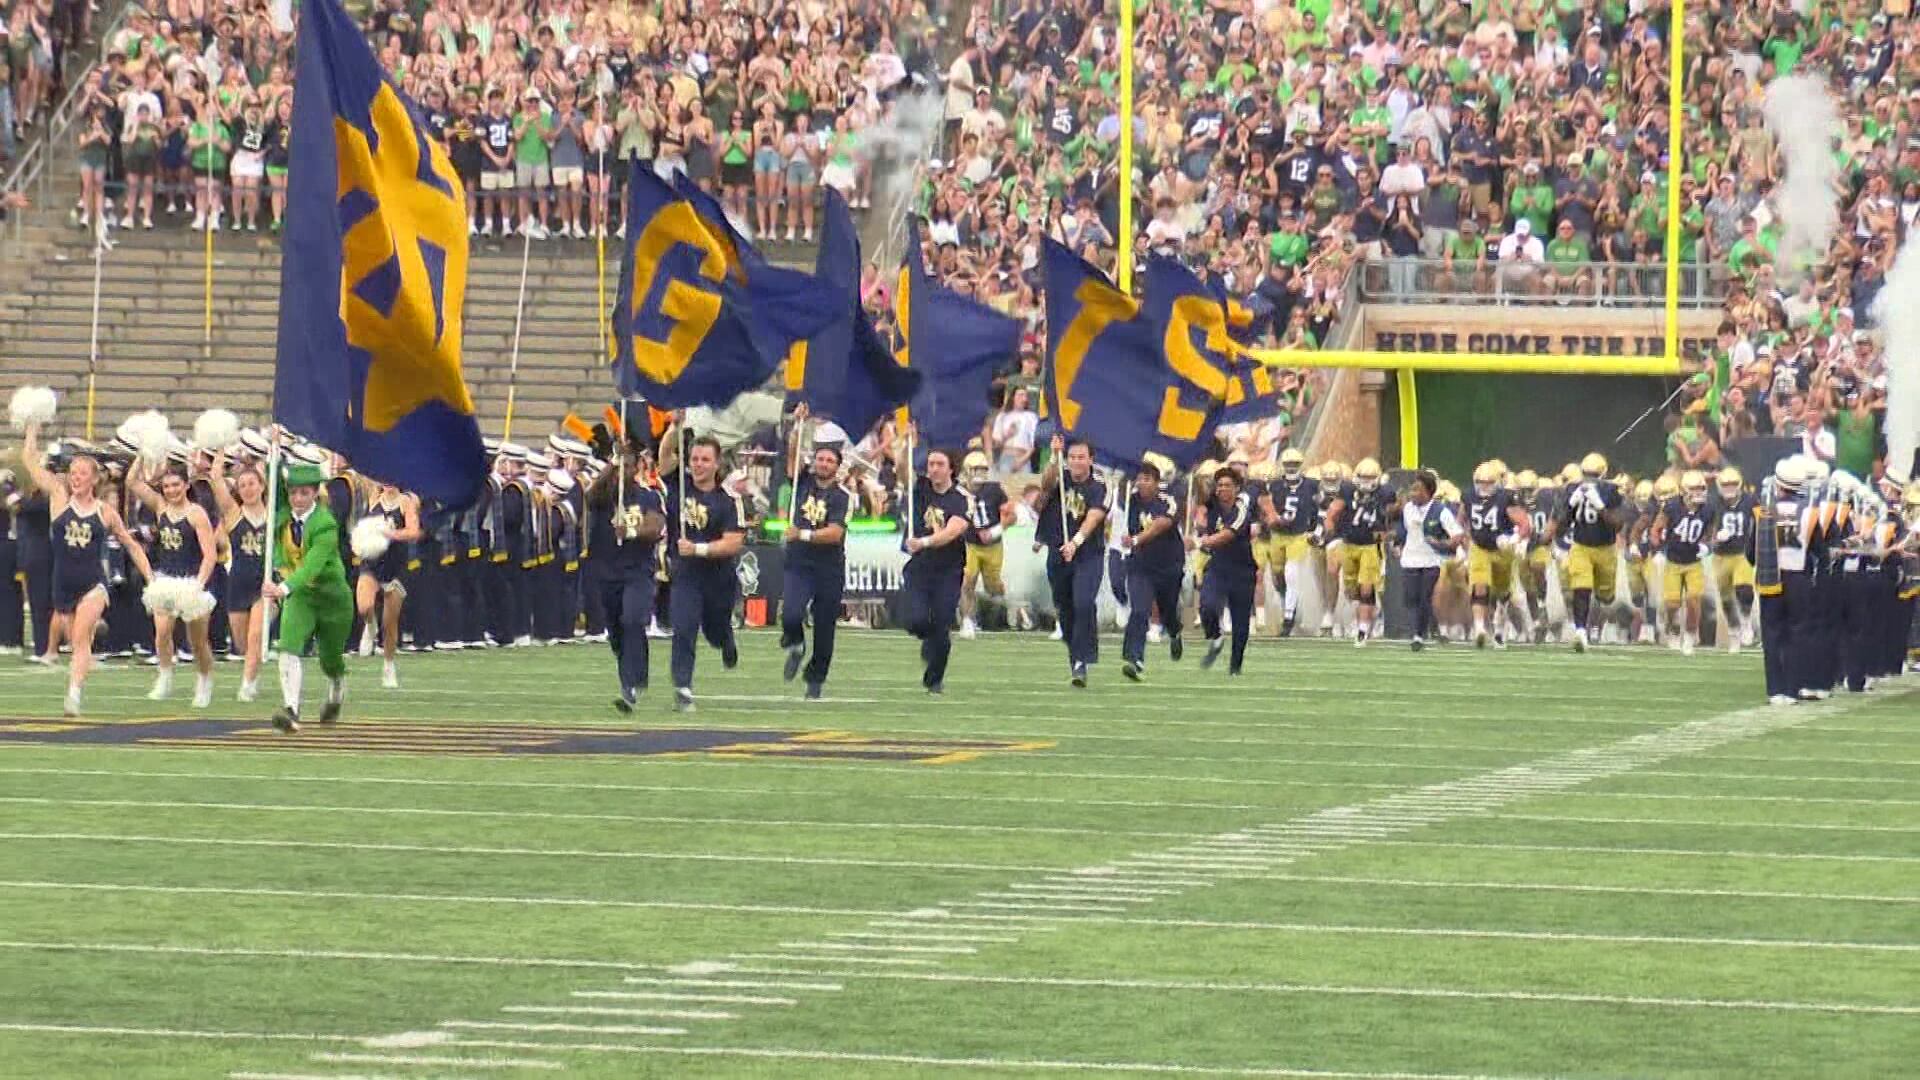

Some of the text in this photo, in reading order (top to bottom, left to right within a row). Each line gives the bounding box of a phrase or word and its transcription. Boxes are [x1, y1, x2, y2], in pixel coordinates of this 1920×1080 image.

[241, 129, 263, 151] 23
[489, 123, 507, 147] 21
[1290, 157, 1310, 182] 12
[632, 200, 729, 386] G
[1467, 332, 1551, 354] COME
[1560, 335, 1622, 355] THE
[1632, 336, 1718, 360] IRS
[1283, 496, 1300, 521] 5
[1471, 503, 1499, 532] 54
[1533, 510, 1547, 536] 0
[1673, 516, 1704, 544] 40
[1722, 511, 1744, 538] 61
